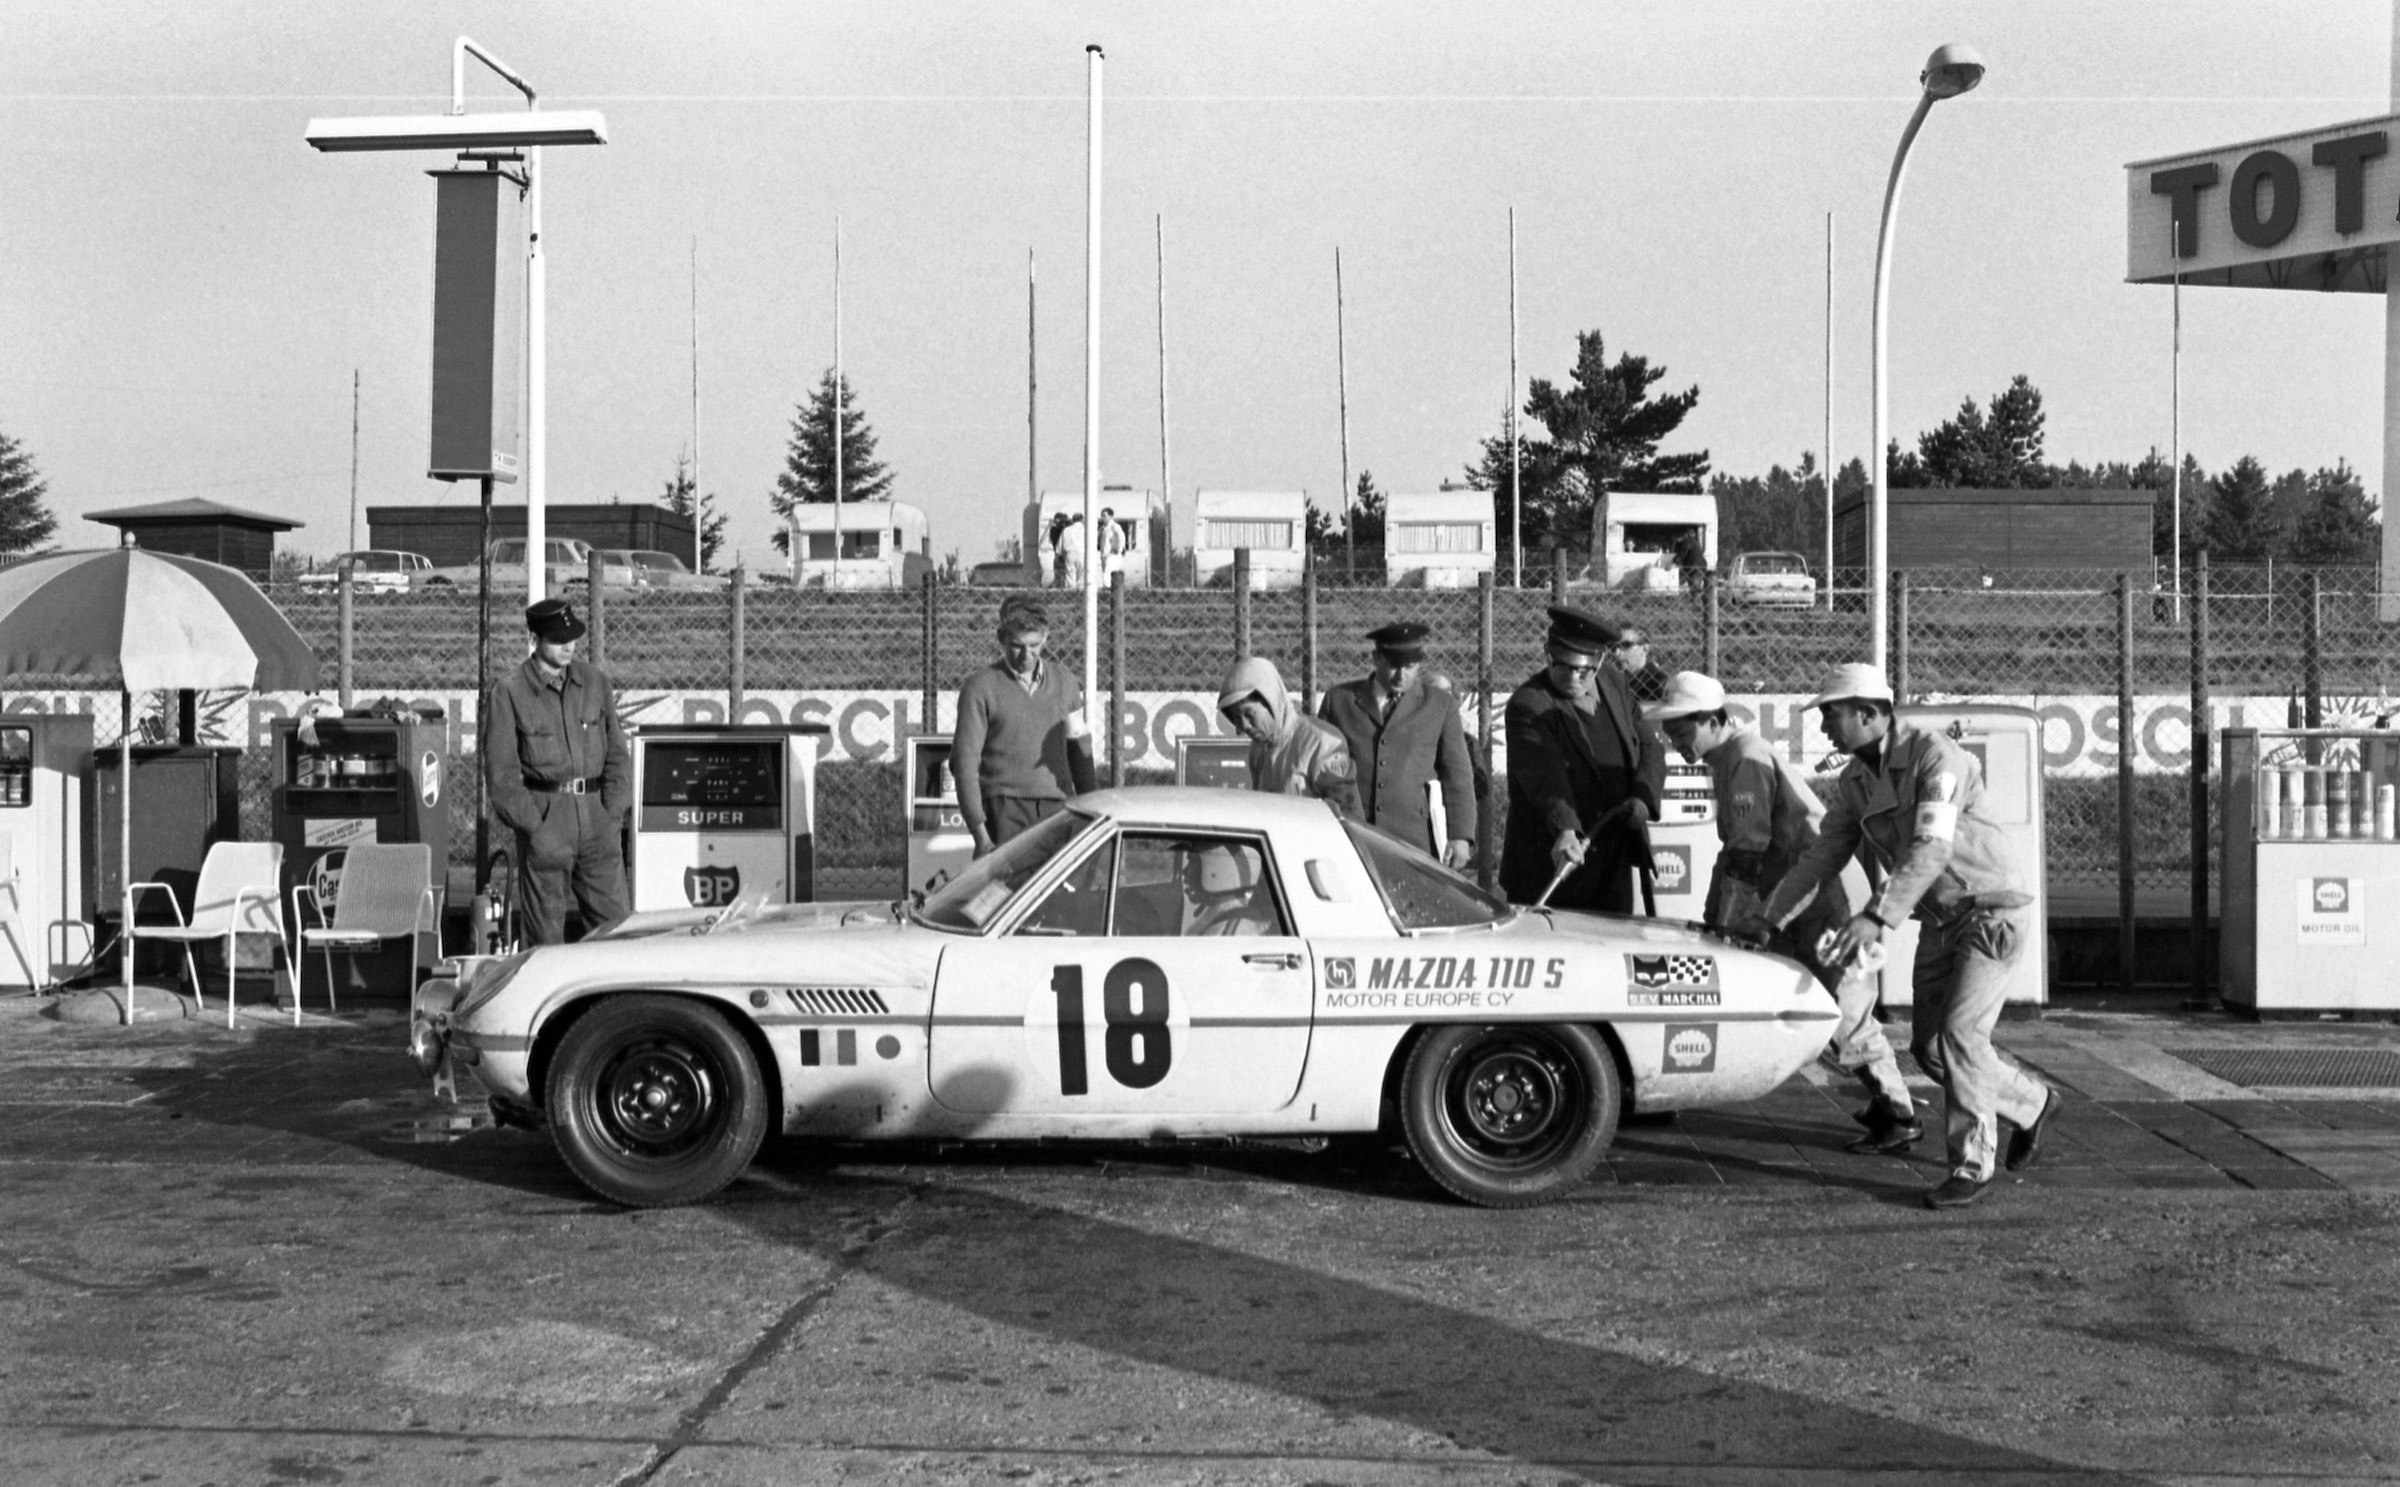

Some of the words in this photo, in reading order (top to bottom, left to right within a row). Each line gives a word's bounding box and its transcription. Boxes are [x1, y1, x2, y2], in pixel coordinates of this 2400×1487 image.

[2151, 131, 2400, 257] TOT
[678, 811, 744, 825] SUPER
[941, 813, 967, 827] LO
[692, 875, 735, 904] BP
[2302, 924, 2340, 933] MOTOR
[2344, 924, 2361, 933] OIL
[1368, 957, 1477, 990] MAZDA
[1487, 957, 1535, 989] 110
[1543, 957, 1566, 989] S
[1326, 992, 1398, 1007] MOTOR
[1403, 992, 1482, 1007] EUROPE
[1486, 992, 1514, 1007] CY
[1662, 993, 1719, 1005] MARCHAL
[1050, 956, 1173, 1096] 18
[1674, 1043, 1706, 1053] SHELL
